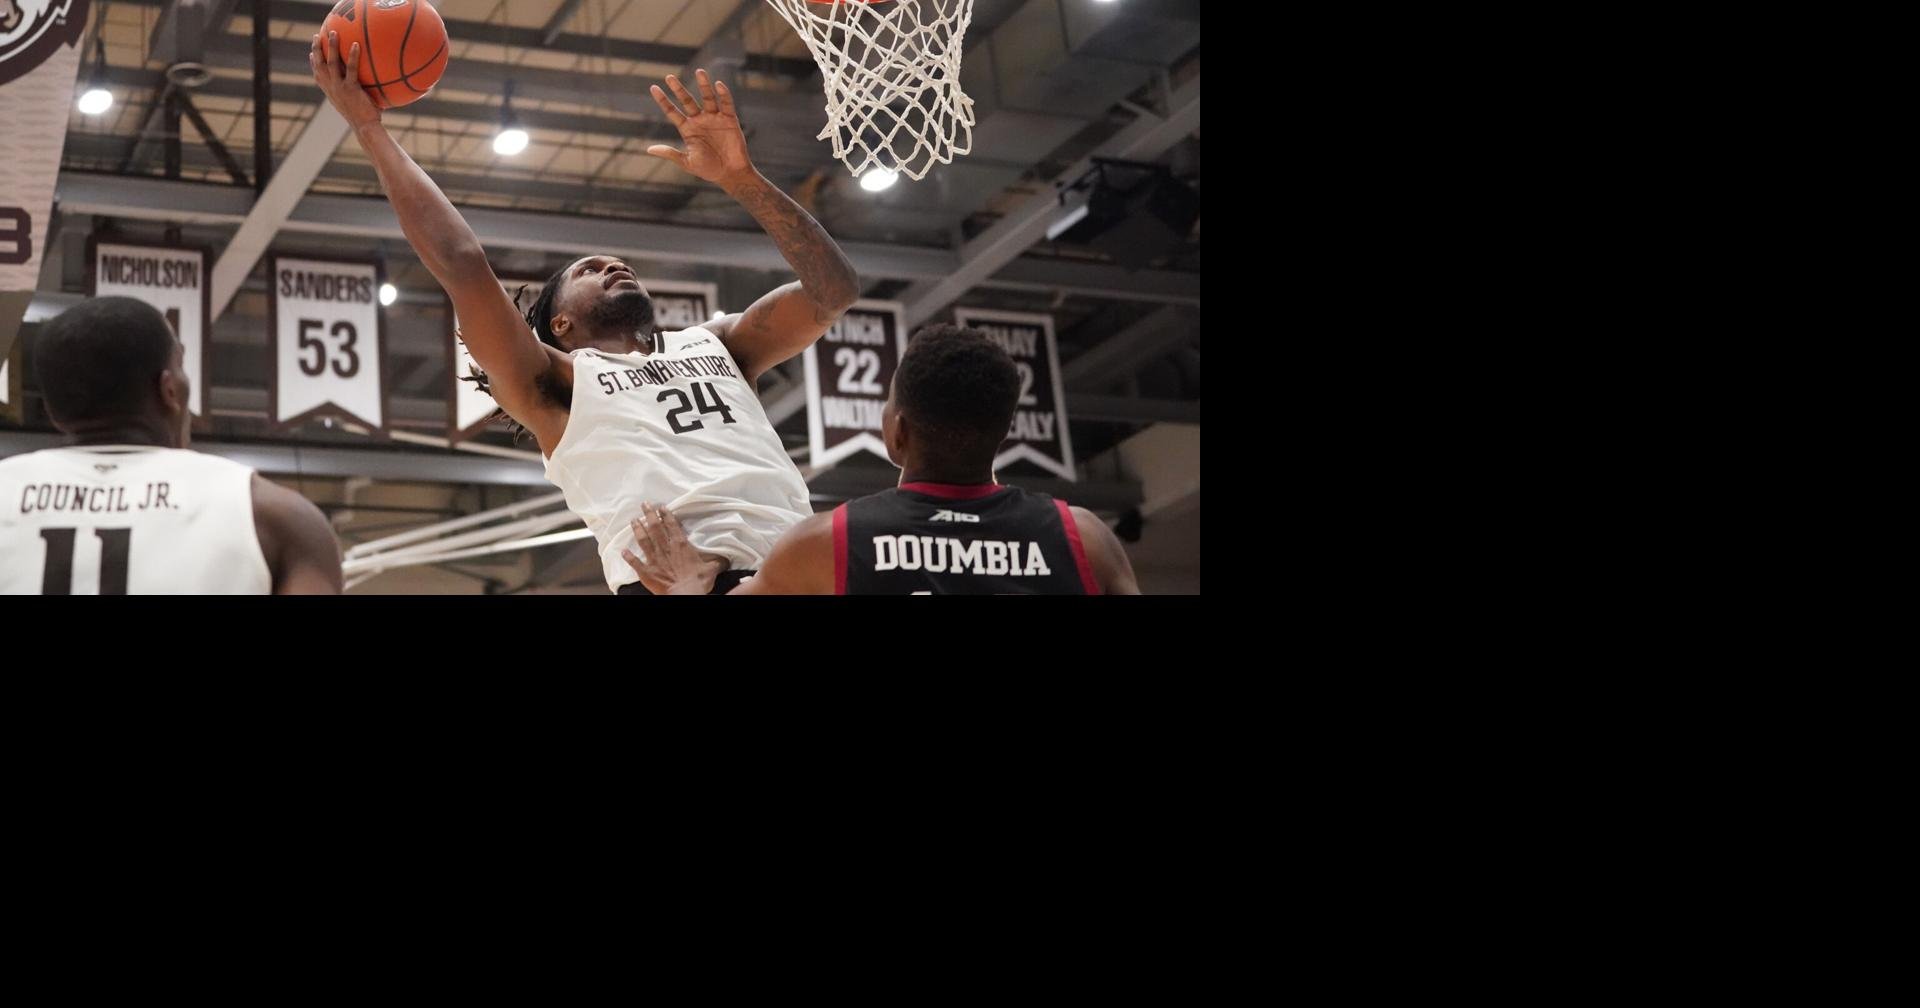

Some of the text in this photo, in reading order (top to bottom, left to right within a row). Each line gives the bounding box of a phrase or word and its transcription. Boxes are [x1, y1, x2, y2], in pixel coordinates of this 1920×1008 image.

[102, 255, 198, 289] NICHOLSON
[281, 269, 372, 305] SANDERS
[298, 319, 359, 379] 53
[624, 355, 737, 388] BONAVENTURE
[834, 347, 883, 394] 22
[1016, 361, 1037, 405] 2
[656, 382, 737, 434] 24
[20, 482, 179, 513] COUNCIL JR.
[39, 527, 132, 595] 11
[873, 535, 1050, 576] DOUMBIA
